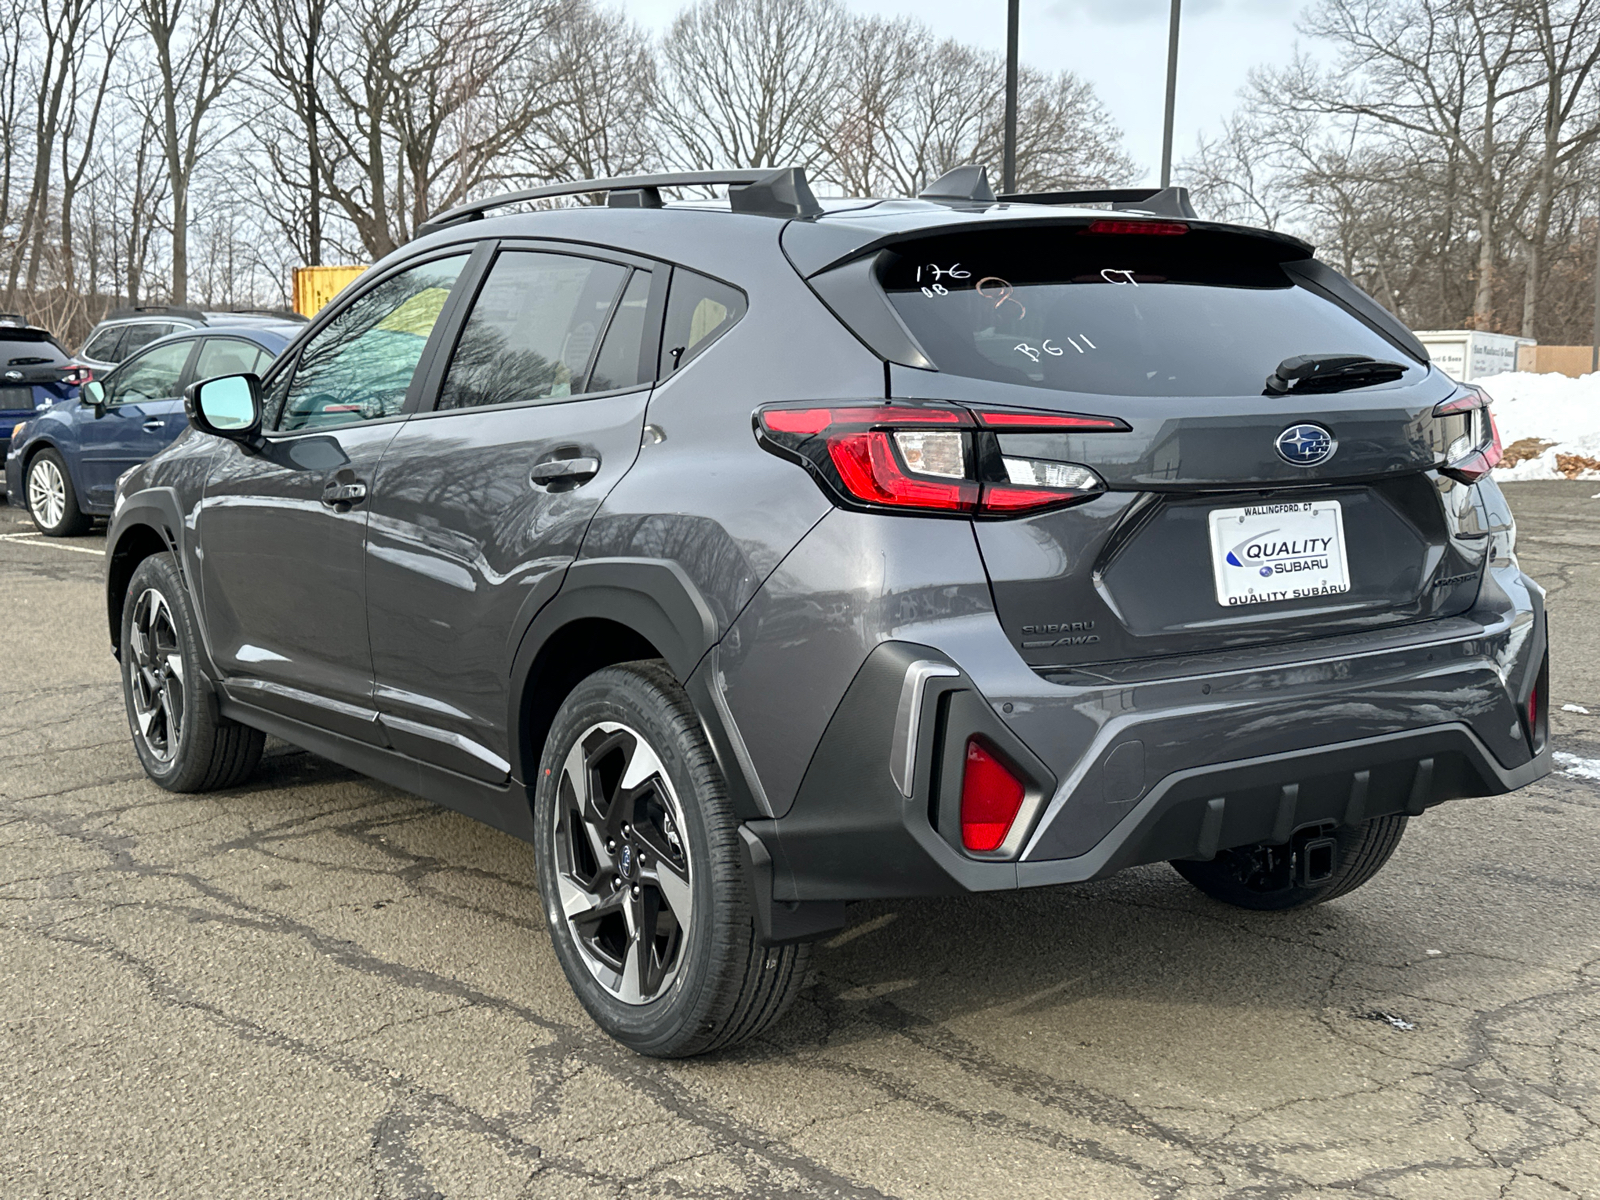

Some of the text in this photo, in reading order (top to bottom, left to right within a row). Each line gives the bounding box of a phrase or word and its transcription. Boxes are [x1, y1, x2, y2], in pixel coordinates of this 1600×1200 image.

[1100, 269, 1139, 287] CT
[1303, 502, 1312, 512] CT
[1246, 537, 1333, 559] QUALITY
[1274, 558, 1329, 574] SUBARU
[1228, 584, 1347, 605] QUALITY SUBARU
[1022, 620, 1095, 635] SUBARU
[1053, 634, 1100, 647] AWD
